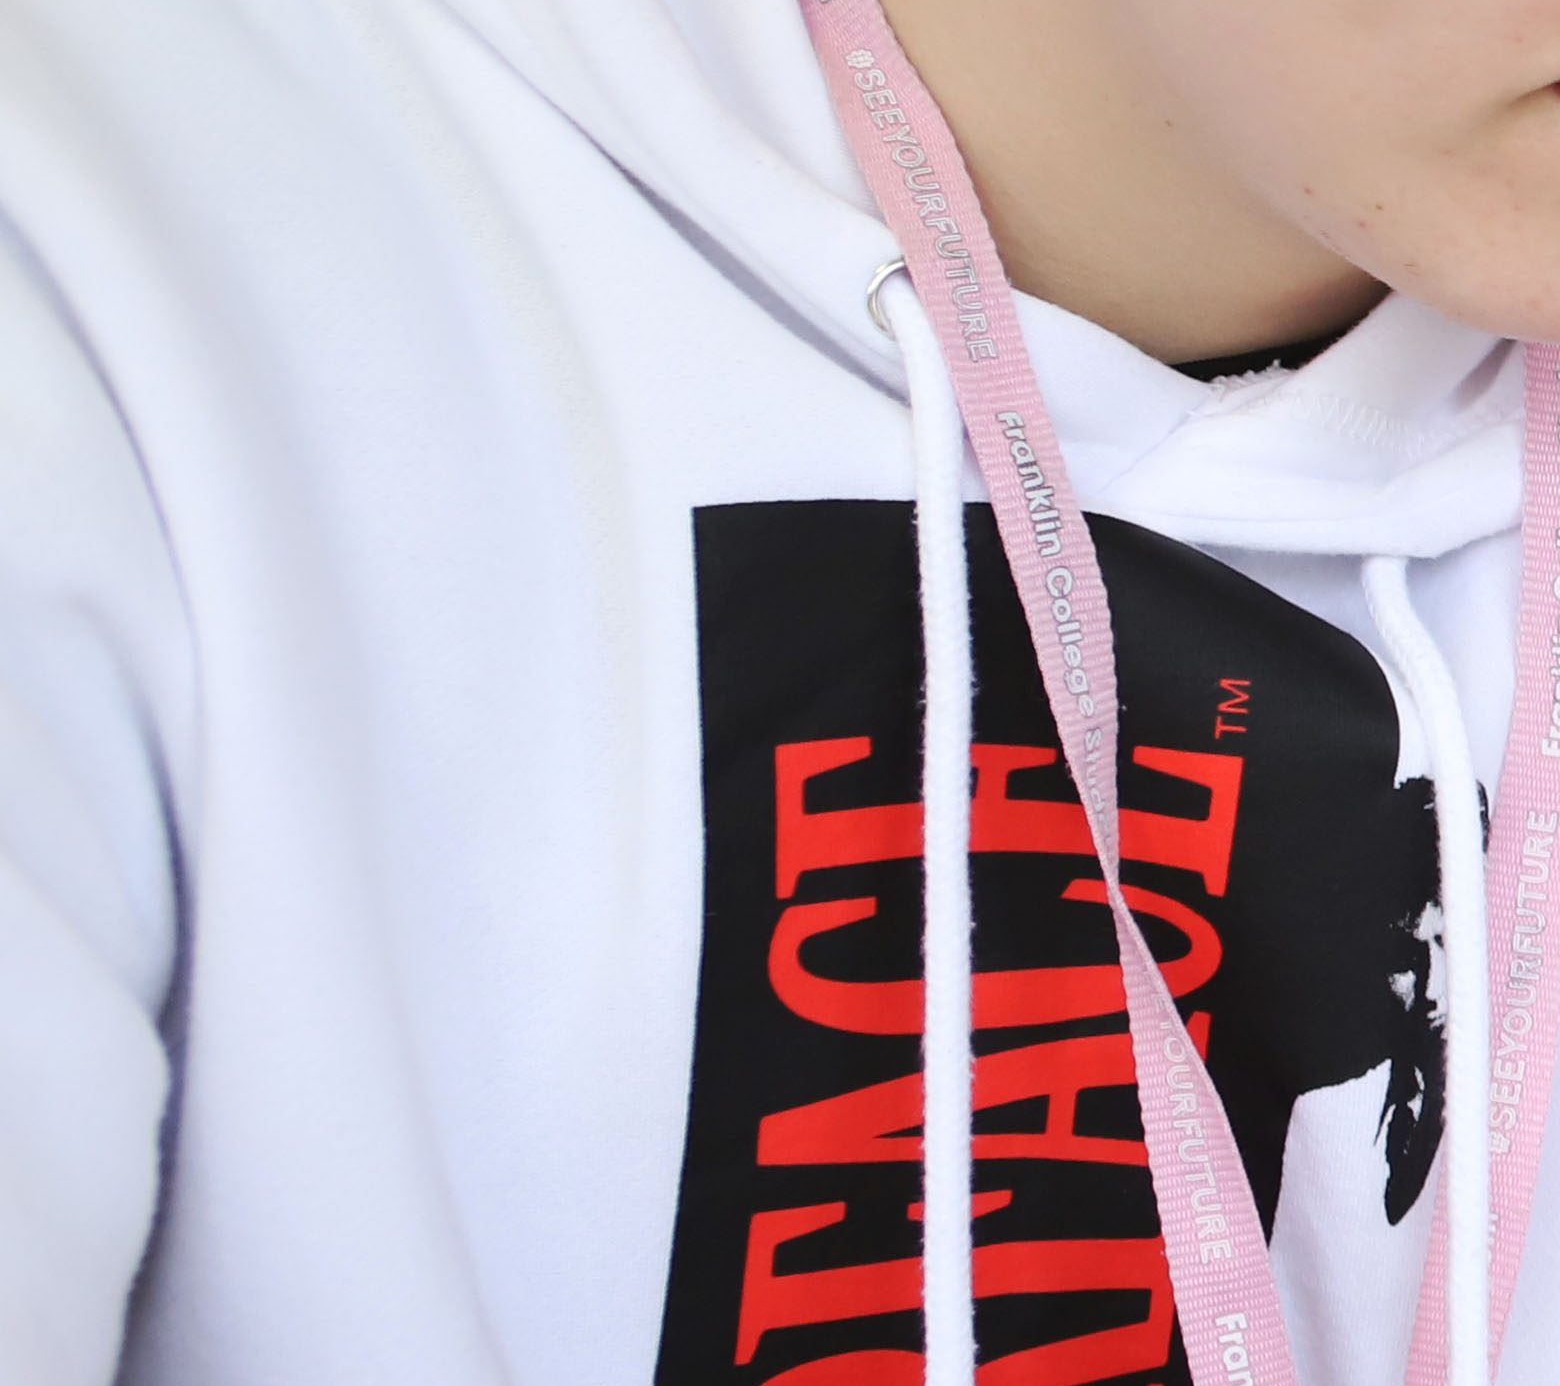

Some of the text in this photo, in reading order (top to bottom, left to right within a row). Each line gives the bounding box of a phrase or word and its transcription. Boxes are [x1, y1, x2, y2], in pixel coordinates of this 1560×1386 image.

[846, 48, 998, 363] #SEEYOURFUTURE
[996, 410, 1063, 558] Franklin
[1045, 565, 1097, 719] College
[1214, 677, 1251, 740] TM
